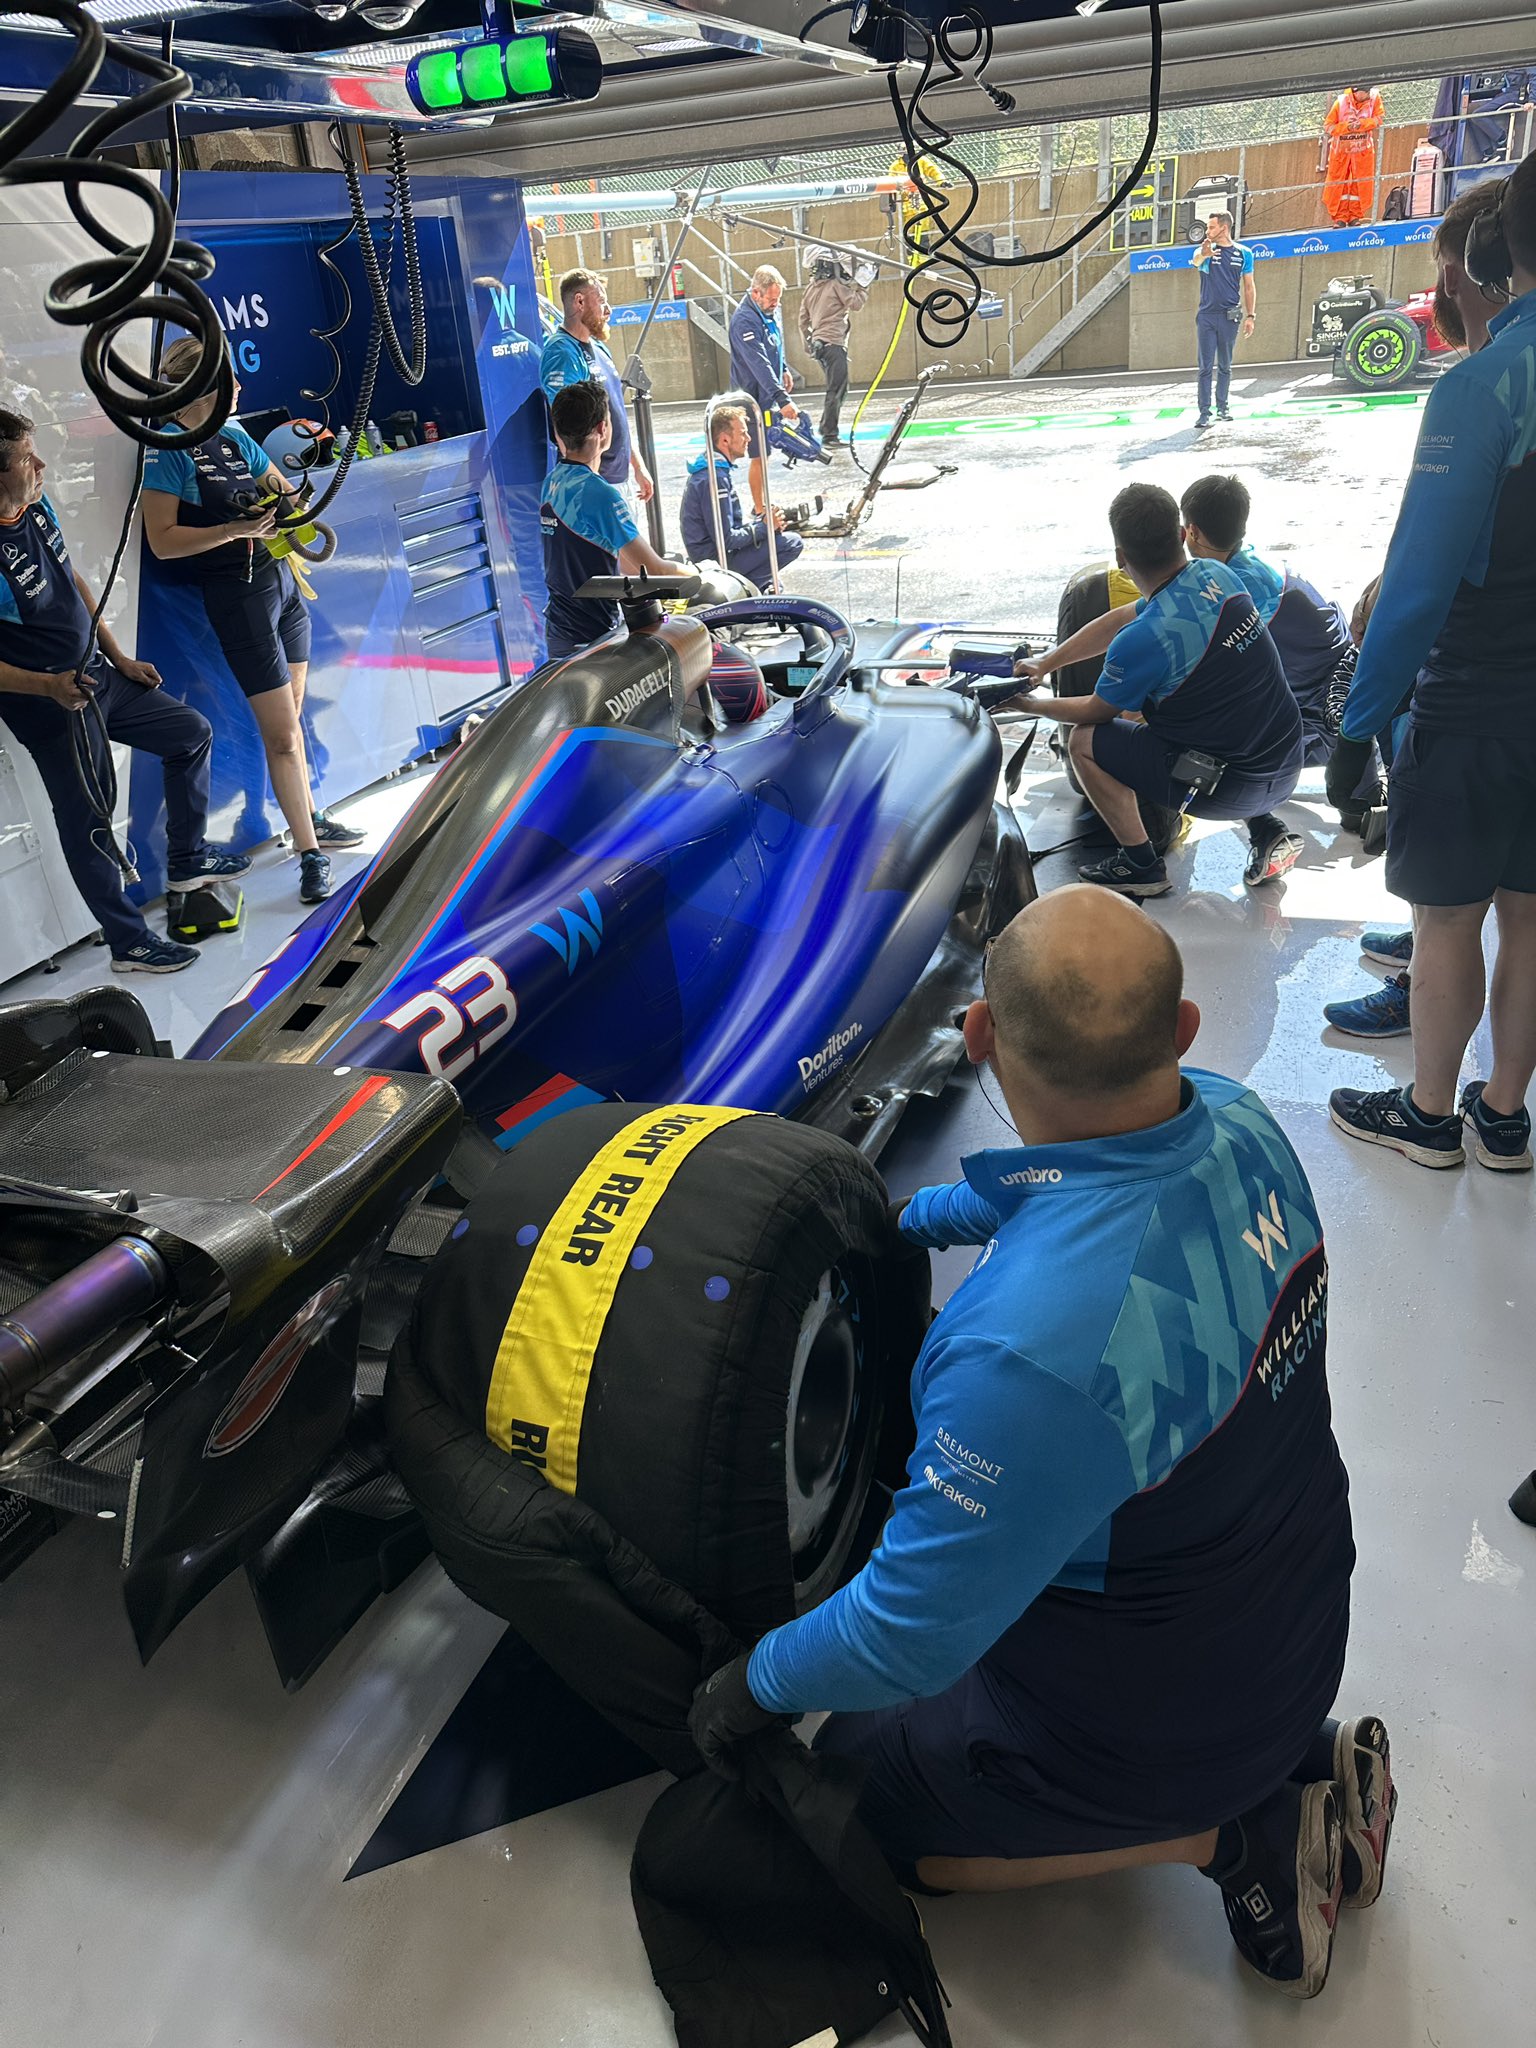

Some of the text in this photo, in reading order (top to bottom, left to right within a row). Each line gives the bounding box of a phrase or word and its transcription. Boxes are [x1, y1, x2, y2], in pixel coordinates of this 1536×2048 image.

[843, 183, 868, 194] Gulf
[1138, 261, 1170, 270] workday
[1293, 244, 1329, 254] workday
[1348, 237, 1385, 248] workday
[1405, 230, 1434, 242] workd
[615, 311, 681, 324] workday workday
[1316, 331, 1347, 340] SINGHA
[1222, 606, 1260, 649] WILLIAM
[605, 668, 669, 720] DURACELL
[380, 954, 520, 1081] 23
[803, 1054, 844, 1094] Ventures
[560, 1113, 707, 1267] RIGHT REAR
[999, 1166, 1063, 1186] umbro
[1256, 1259, 1328, 1385] WILLIAM
[936, 1426, 1005, 1478] BREMONT
[930, 1472, 987, 1519] kraken
